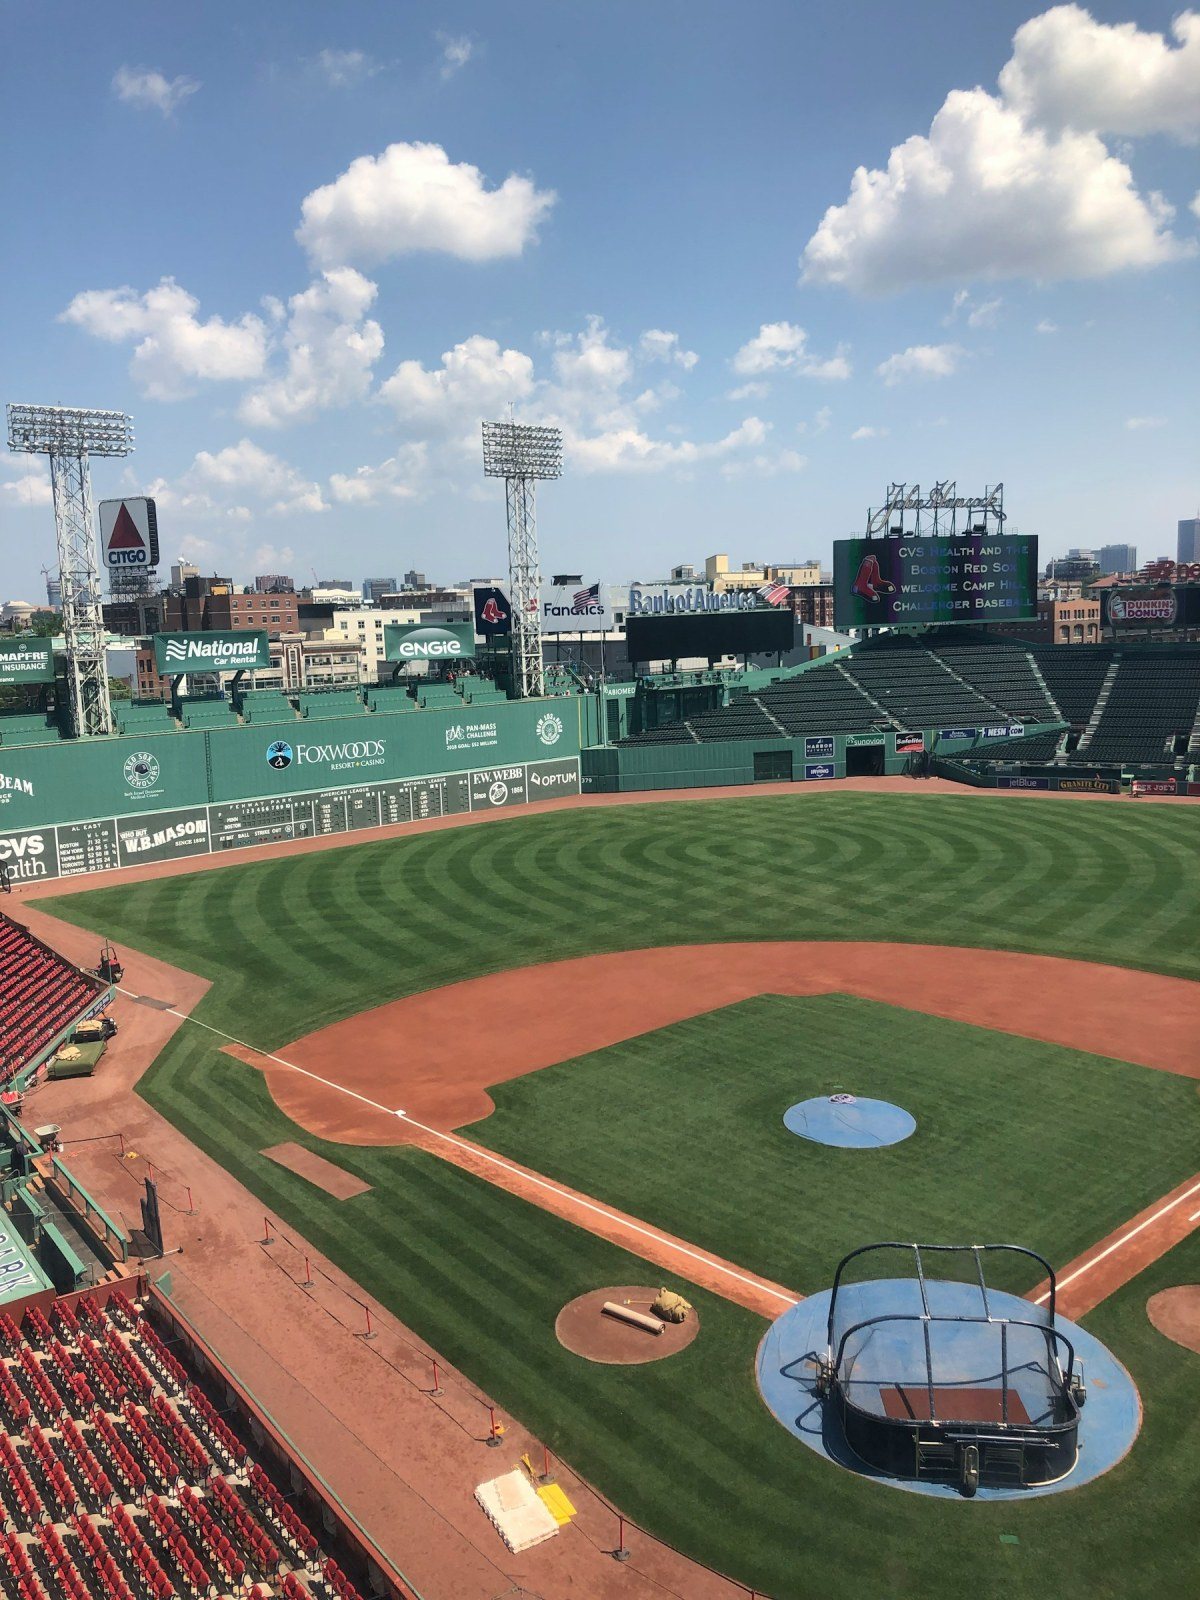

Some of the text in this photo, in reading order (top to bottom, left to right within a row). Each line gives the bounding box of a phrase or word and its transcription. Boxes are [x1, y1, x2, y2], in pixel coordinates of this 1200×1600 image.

[866, 480, 1007, 533] John Hancock
[898, 547, 924, 557] CVS
[629, 588, 757, 614] Bank of America
[1127, 608, 1170, 617] DONUTS
[0, 651, 48, 661] MAPFRE
[214, 655, 257, 665] Car Rental
[2, 662, 47, 671] INSURANCE
[608, 687, 635, 695] ABIOMED
[466, 723, 497, 732] PAN-MASS
[466, 730, 497, 738] CHALLENGE
[125, 753, 153, 770] RED SOX
[127, 765, 158, 787] SCHOLARS
[492, 767, 523, 781] WEBB
[542, 771, 577, 787] OPTUM
[1009, 778, 1037, 788] jetBlue
[230, 802, 264, 810] FENWAY
[120, 828, 148, 840] WHO BUT
[0, 835, 44, 860] CVS
[4, 858, 48, 880] alth
[62, 867, 87, 875] BALTIMORE
